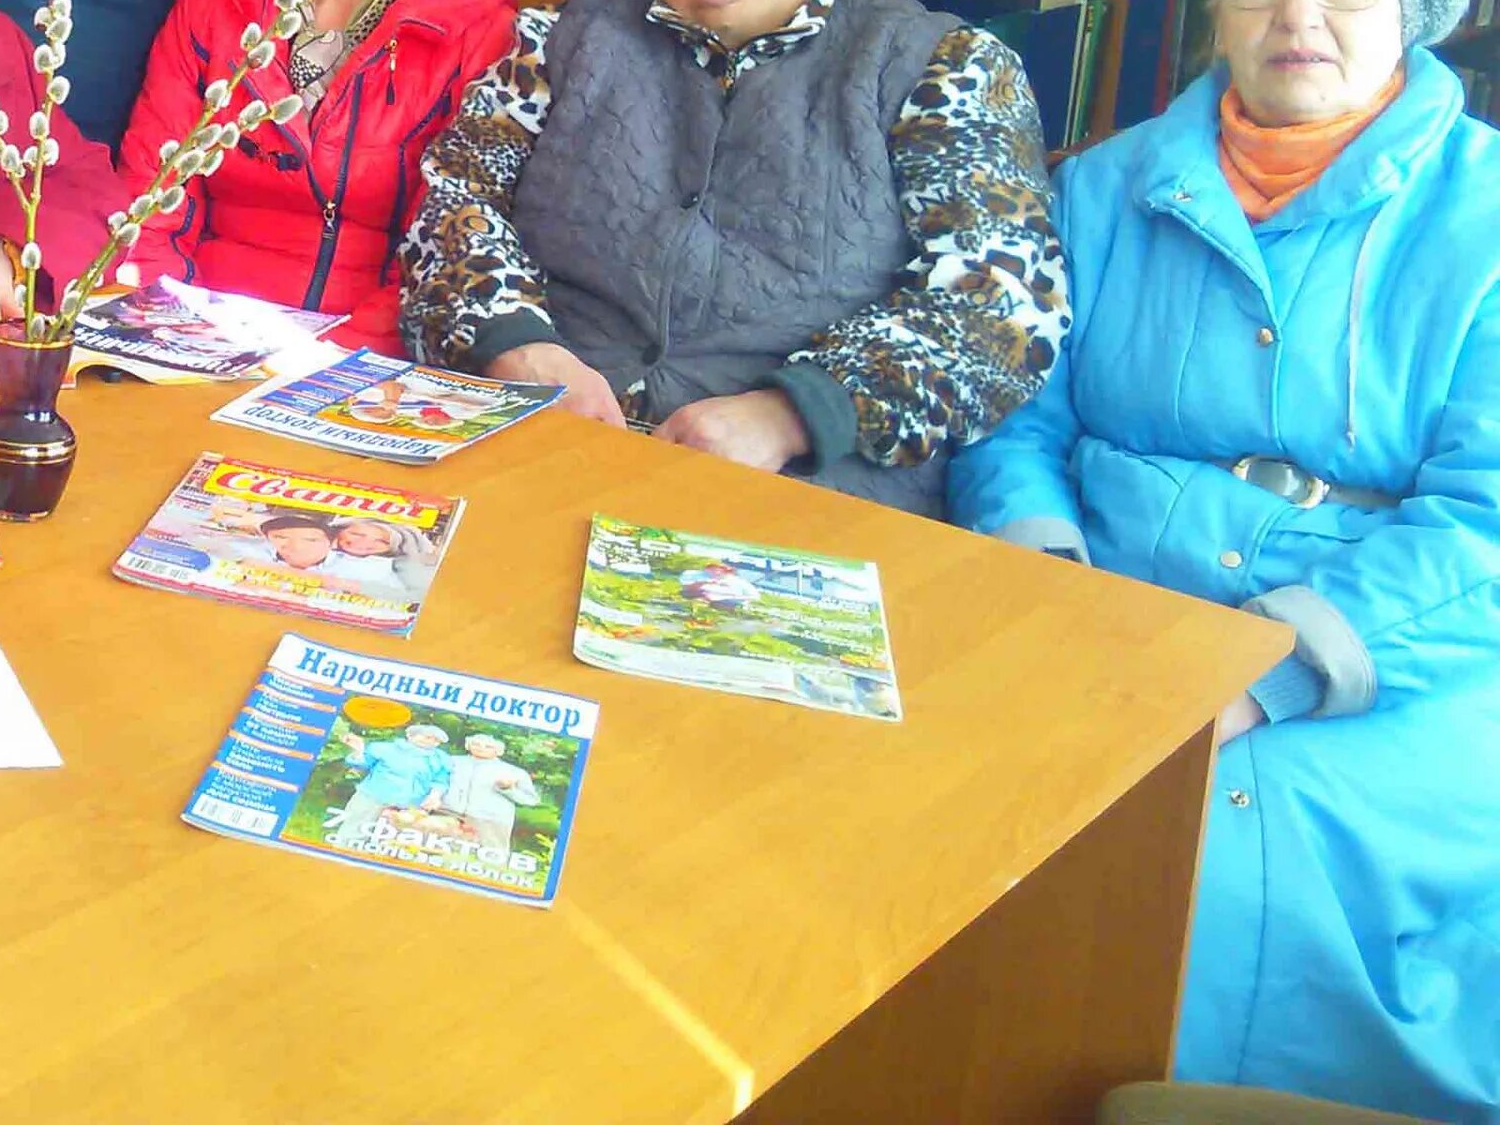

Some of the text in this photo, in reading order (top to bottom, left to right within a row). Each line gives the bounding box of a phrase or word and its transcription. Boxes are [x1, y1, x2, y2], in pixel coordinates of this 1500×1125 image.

[216, 470, 427, 517] Сваты
[296, 646, 581, 734] Народный доктор
[360, 816, 539, 874] фактов
